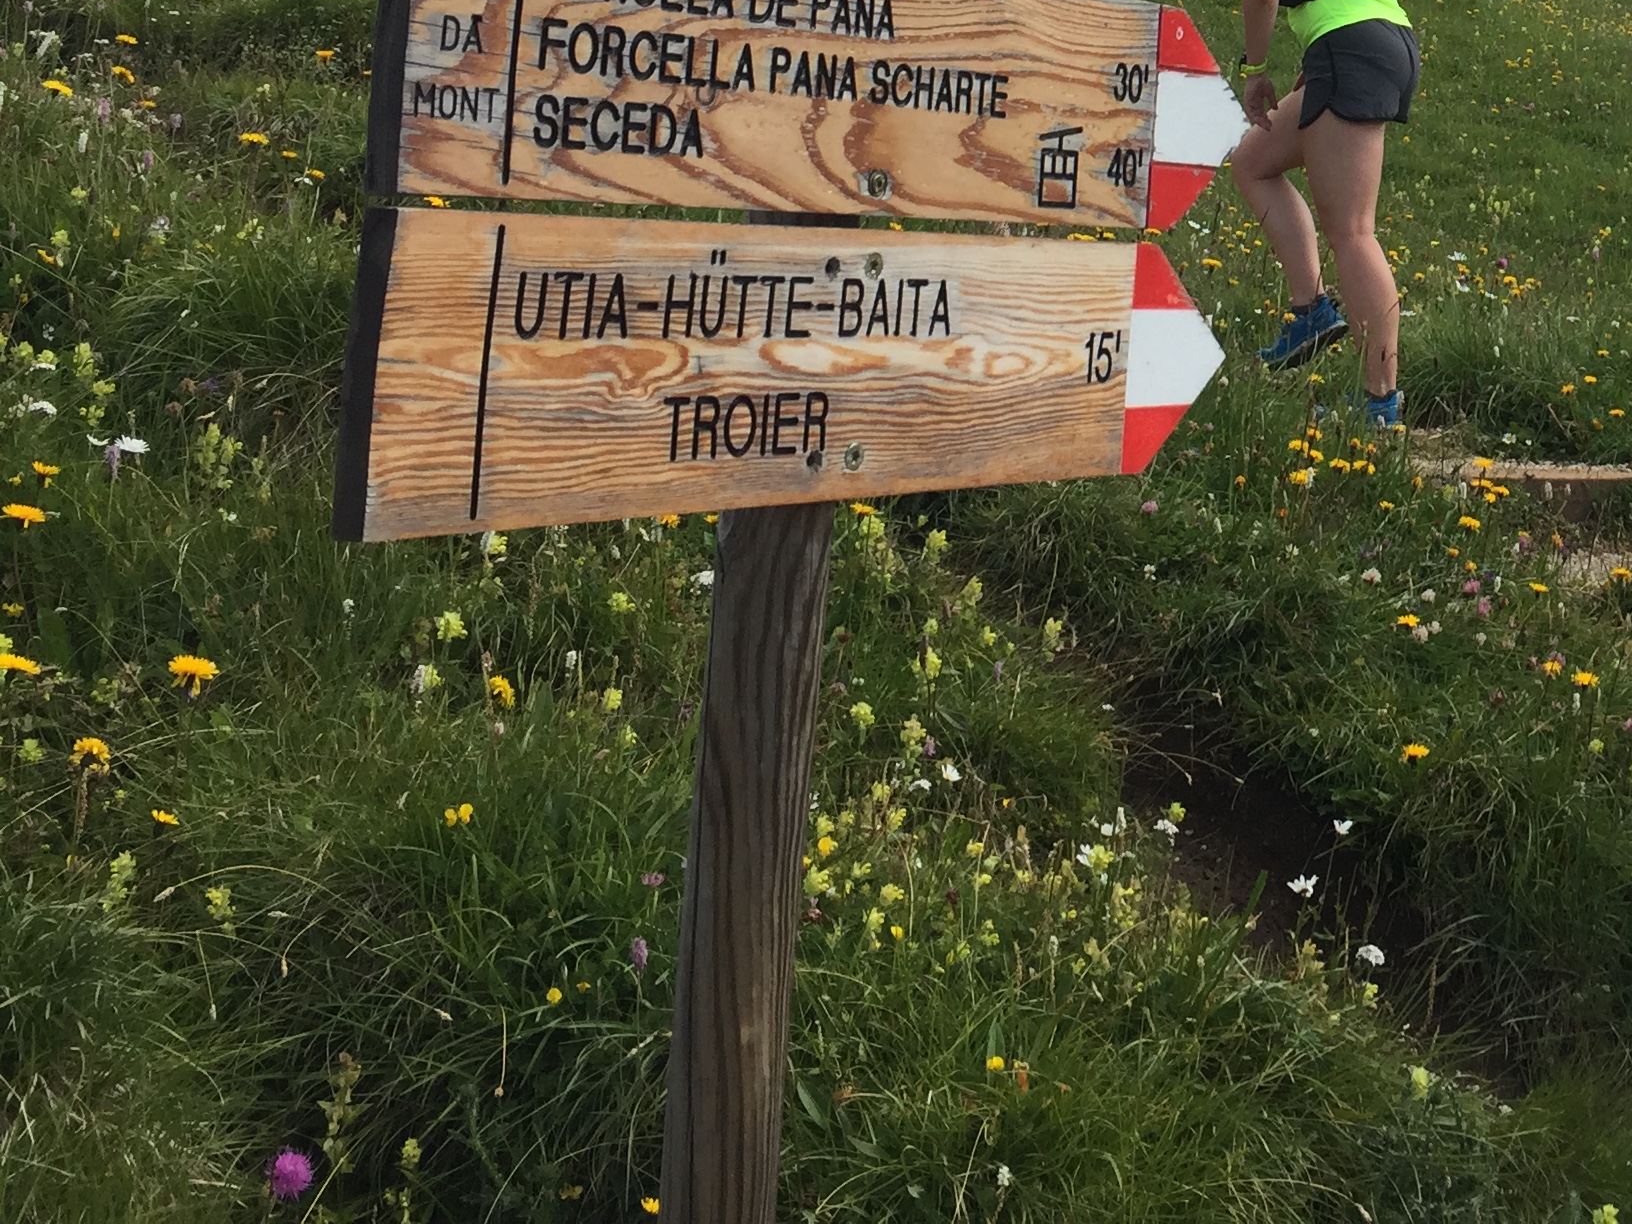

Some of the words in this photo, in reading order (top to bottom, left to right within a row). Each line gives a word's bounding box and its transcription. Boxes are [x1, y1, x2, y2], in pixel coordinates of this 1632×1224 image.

[440, 14, 483, 54] DA
[538, 17, 755, 92] FORCELLA
[769, 47, 857, 101] PANA
[868, 60, 1009, 119] SCHARTE
[413, 81, 500, 123] MONT
[533, 94, 703, 158] SECEDA
[664, 392, 829, 461] TROIER
